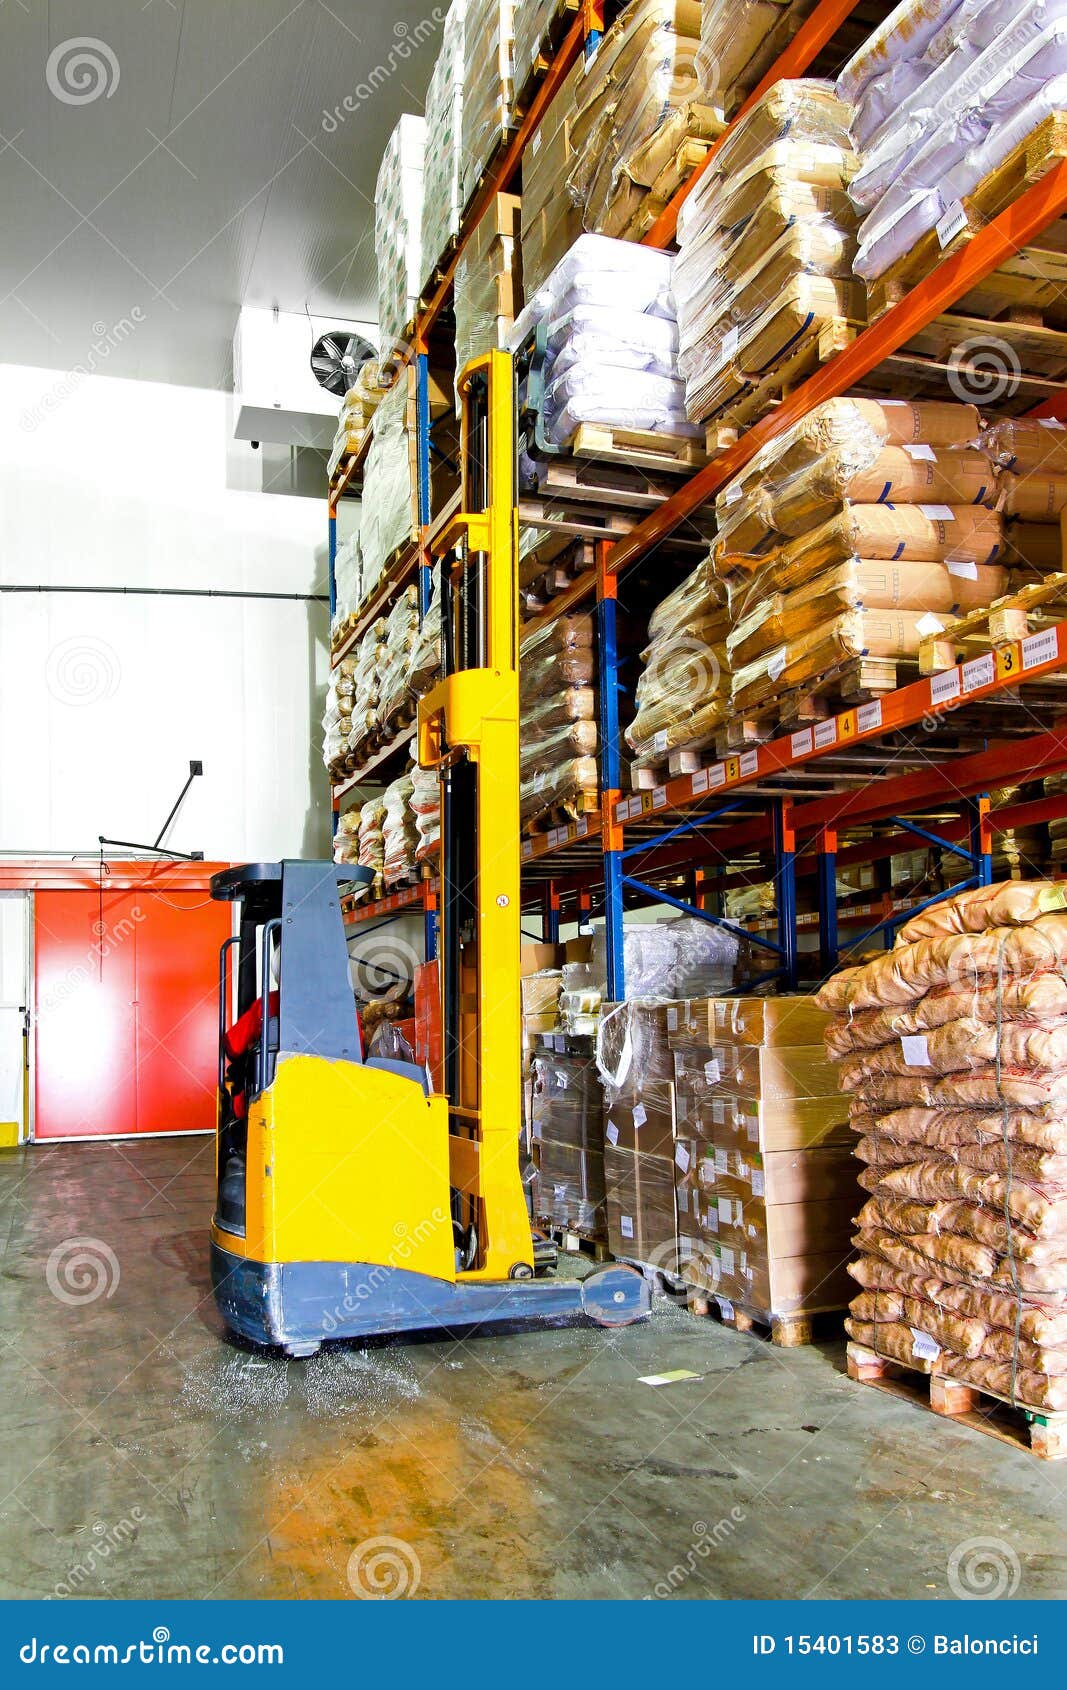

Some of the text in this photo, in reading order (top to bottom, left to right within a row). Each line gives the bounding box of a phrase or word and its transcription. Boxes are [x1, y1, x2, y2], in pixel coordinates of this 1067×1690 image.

[1004, 652, 1013, 671] 3
[843, 718, 850, 733] 4
[730, 762, 736, 777] 5
